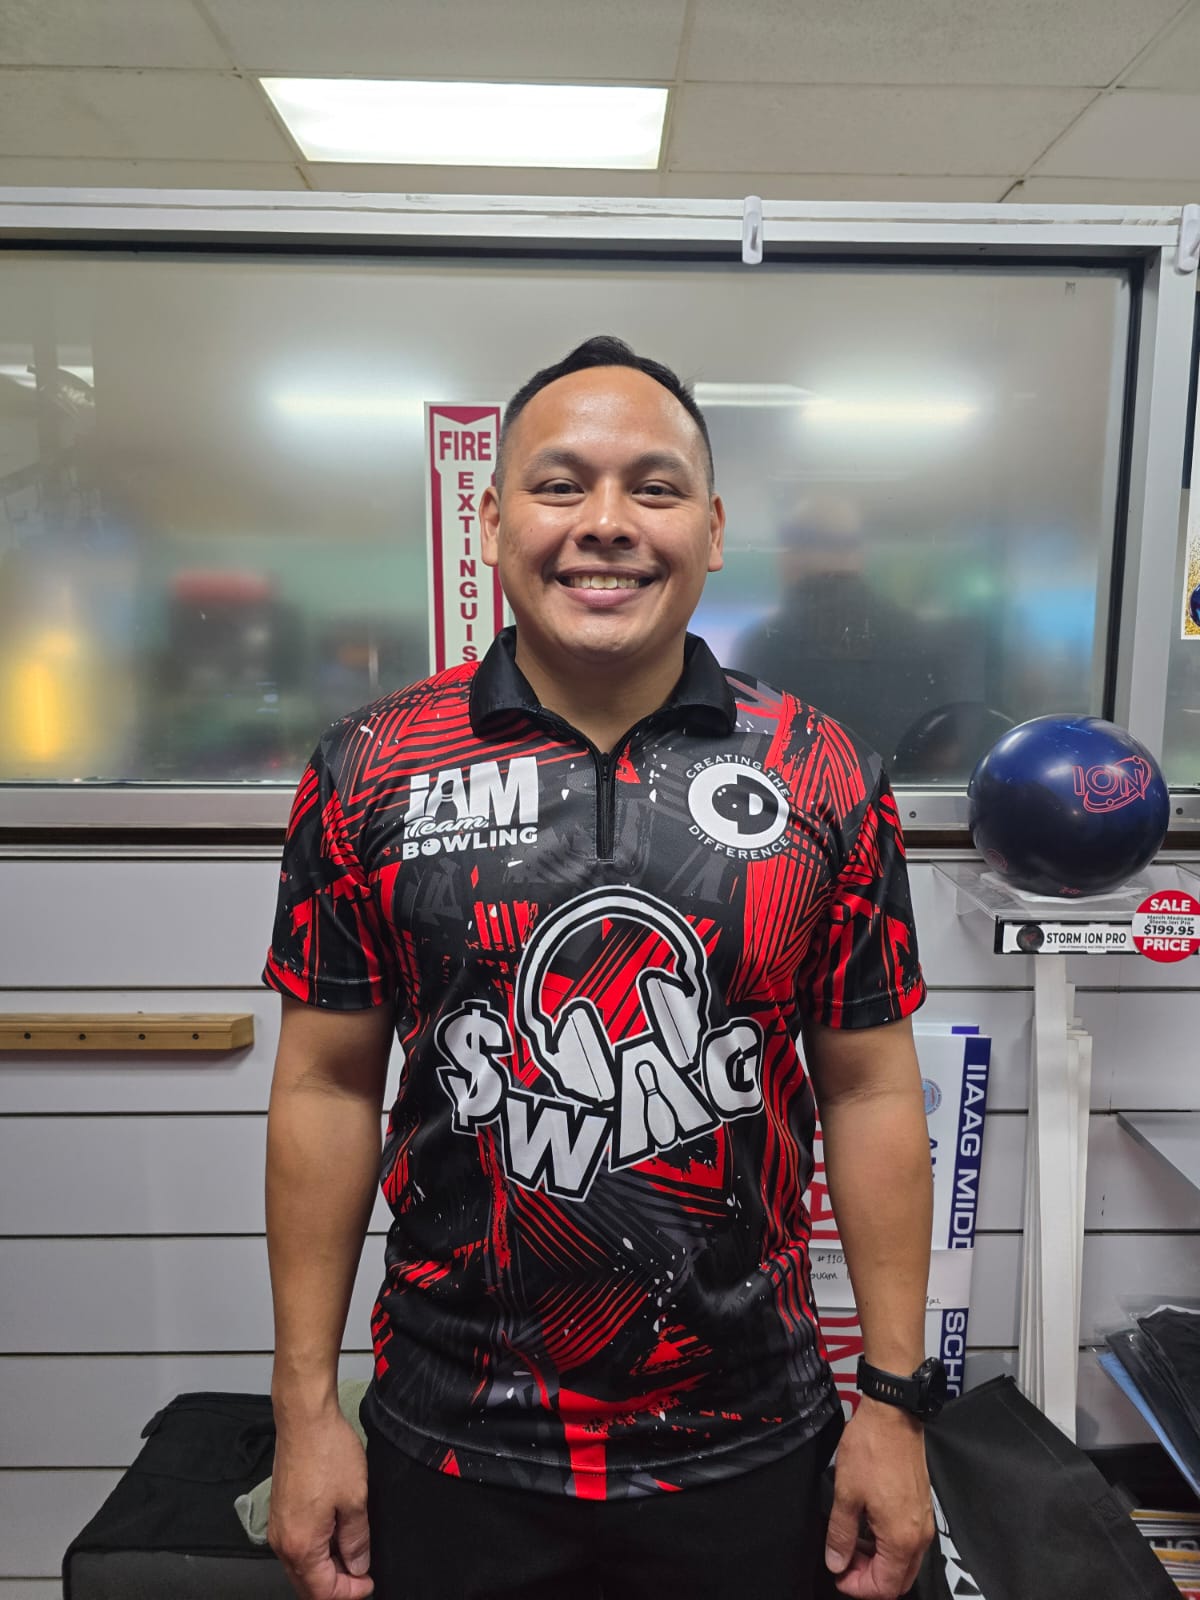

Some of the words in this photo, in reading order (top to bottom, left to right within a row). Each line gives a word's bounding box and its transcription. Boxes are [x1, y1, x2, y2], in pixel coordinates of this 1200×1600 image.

[440, 431, 492, 461] FIRE
[686, 754, 762, 779] CREATING
[767, 770, 791, 798] THE
[1072, 763, 1147, 801] ION
[408, 816, 489, 838] Team
[689, 824, 790, 860] DIFFERENCE
[402, 827, 538, 861] BOWLING
[1150, 898, 1191, 912] SALE
[1046, 932, 1081, 944] STORM
[1084, 932, 1103, 944] ION
[1105, 932, 1127, 944] PRO
[1143, 924, 1195, 936] $199.95
[1143, 938, 1191, 952] PRICE
[959, 1064, 987, 1157] IIAAG
